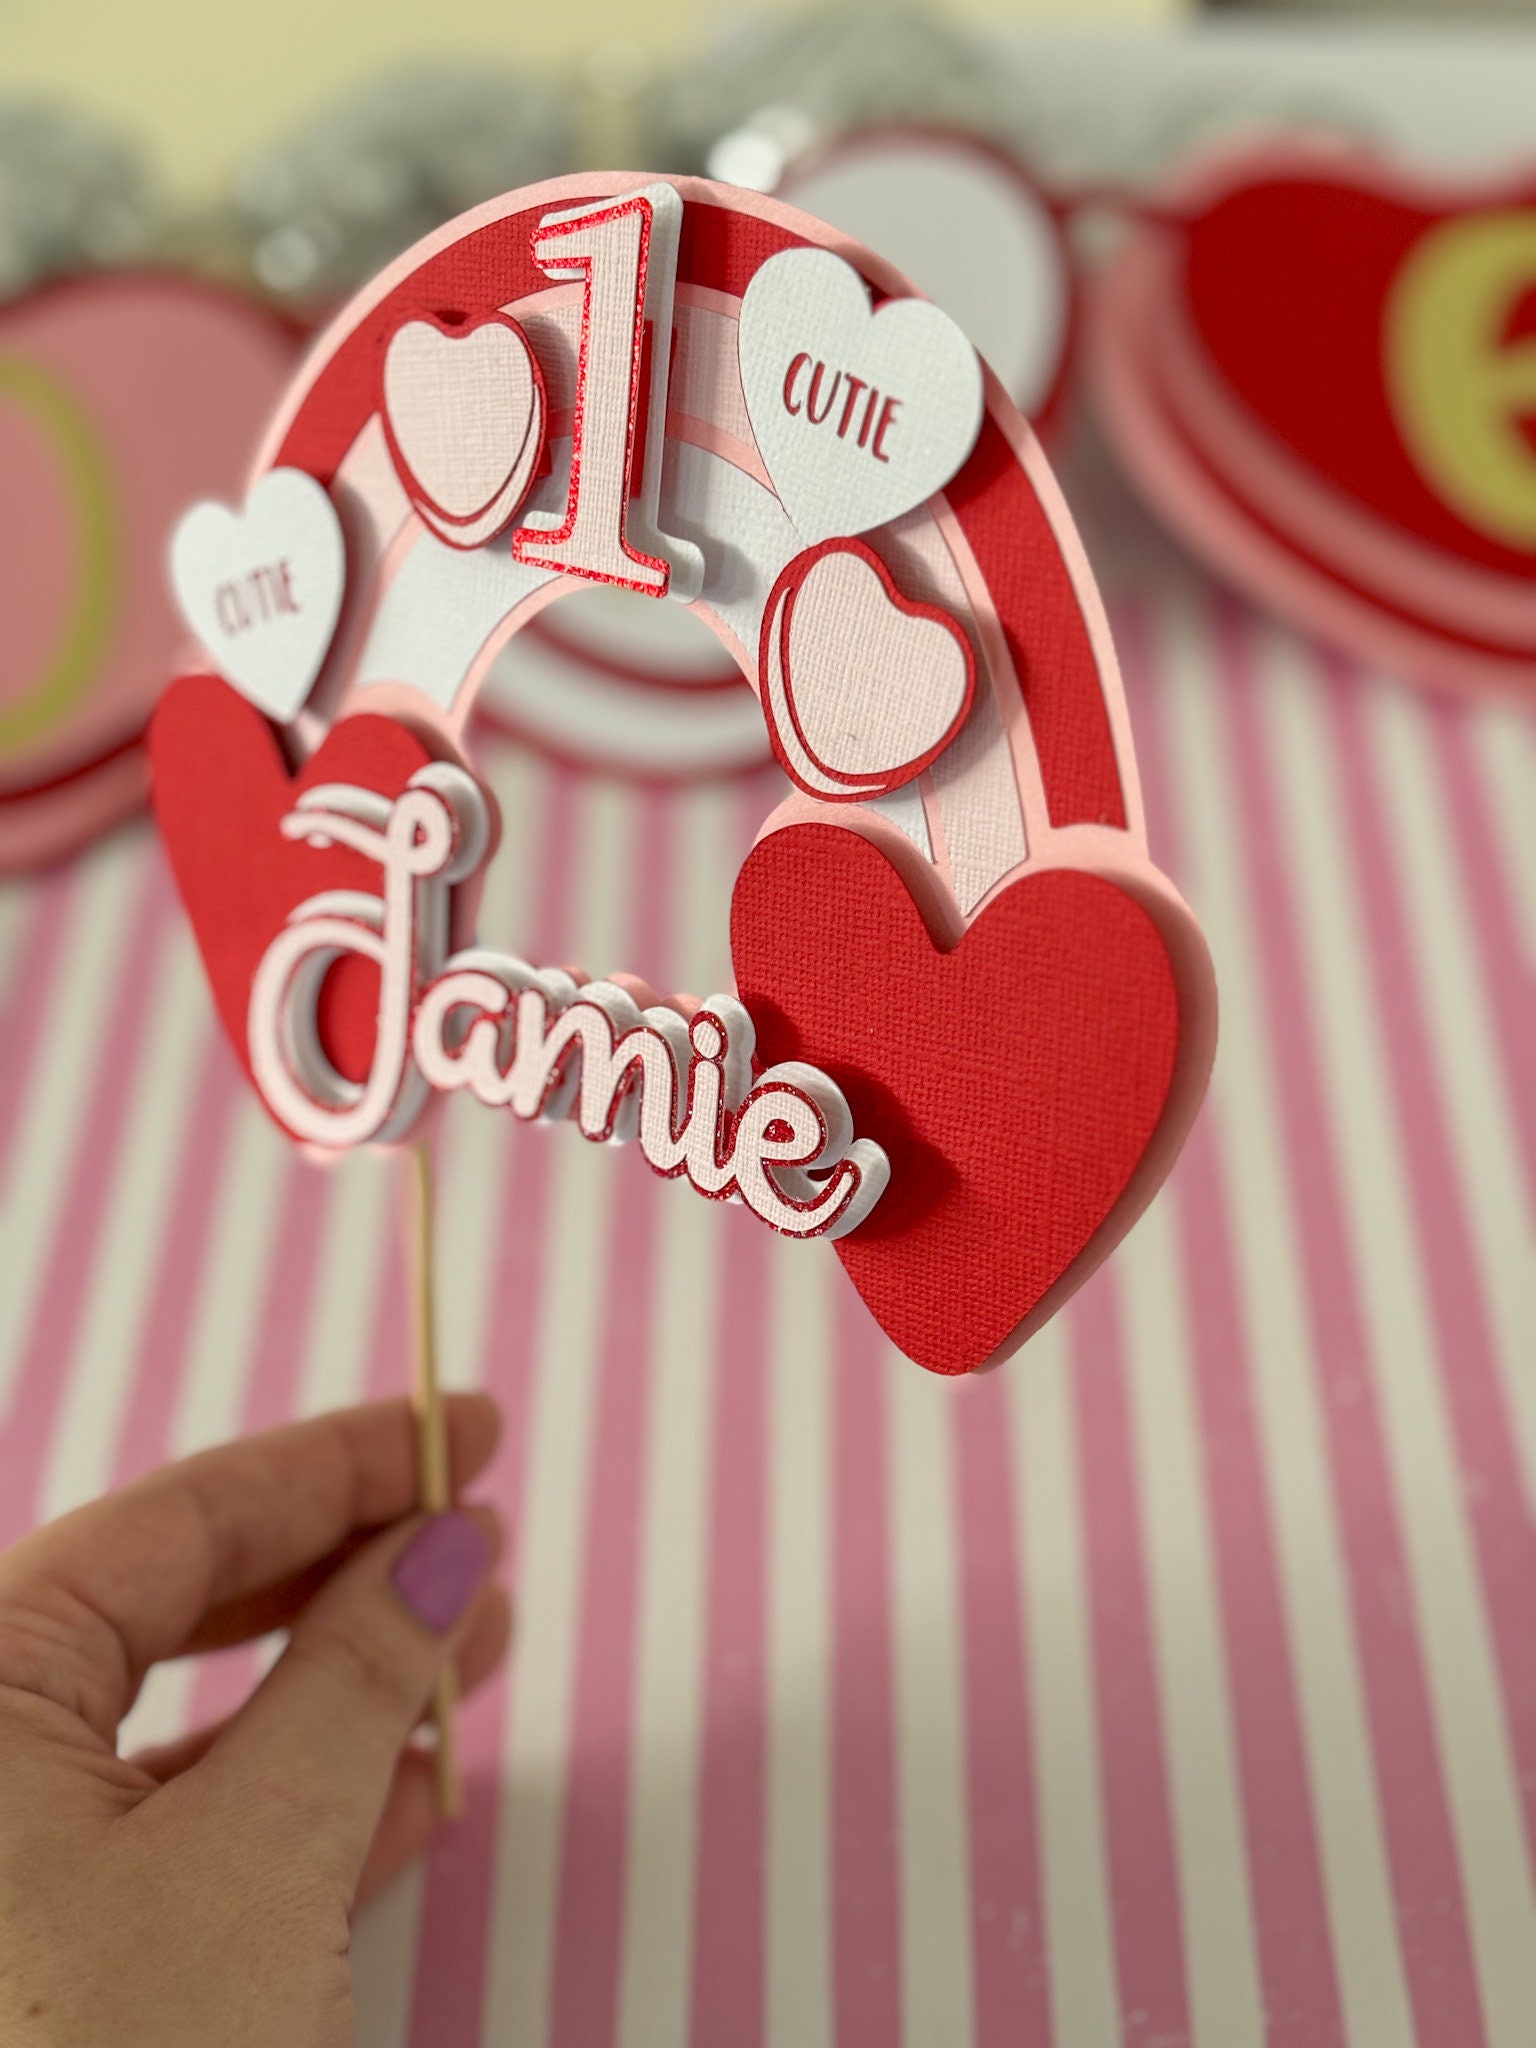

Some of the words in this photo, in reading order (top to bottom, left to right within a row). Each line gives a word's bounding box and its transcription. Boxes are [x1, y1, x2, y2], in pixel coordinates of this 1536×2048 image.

[512, 192, 682, 600] 1
[783, 351, 903, 464] CUTIE
[216, 559, 300, 635] CUTIE
[248, 782, 876, 1240] Jamie
